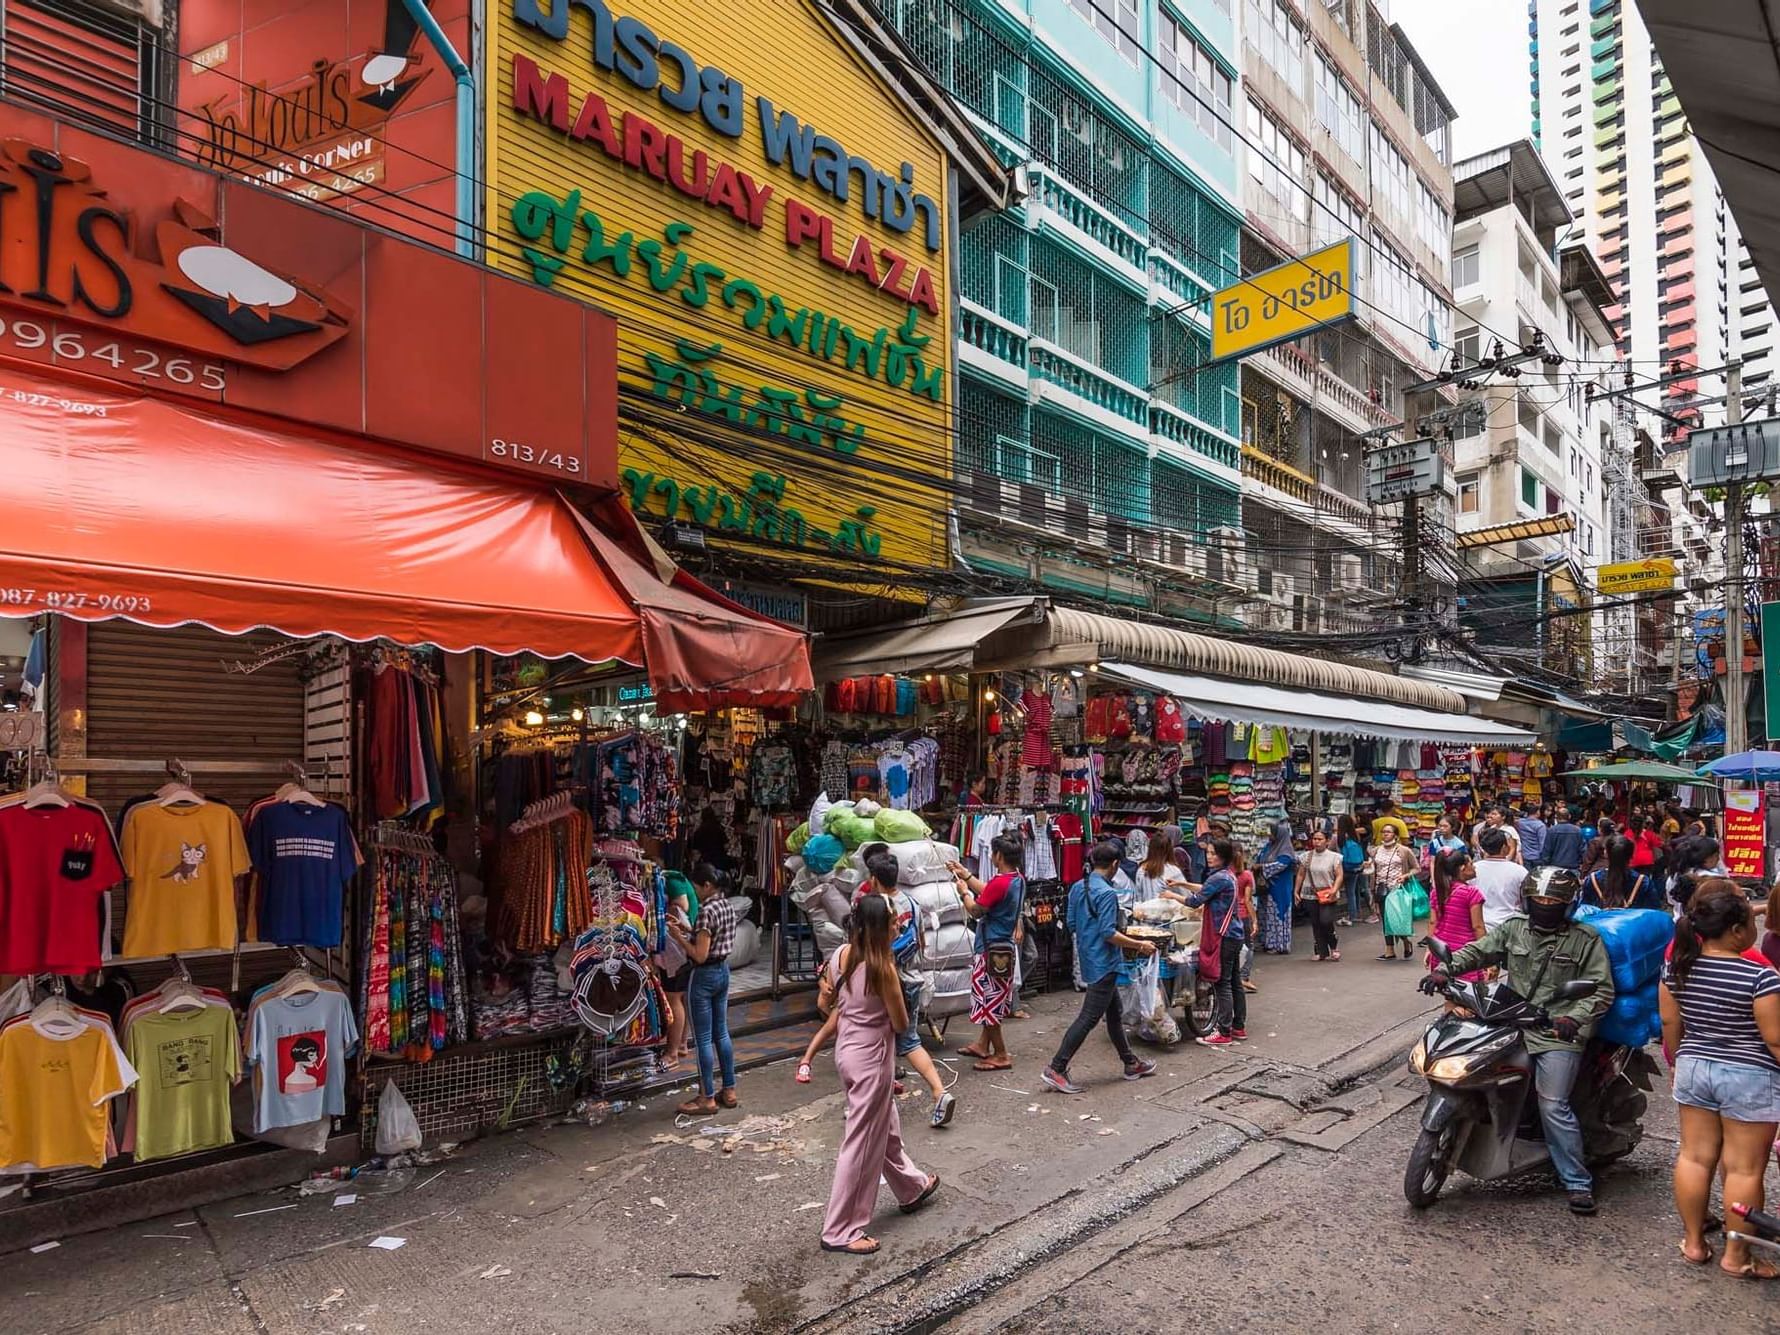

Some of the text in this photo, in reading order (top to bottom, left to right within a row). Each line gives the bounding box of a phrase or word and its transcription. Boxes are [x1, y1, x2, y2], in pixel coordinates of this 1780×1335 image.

[513, 52, 939, 316] MARUAY PLAZA
[757, 96, 939, 252] พลาซ่า
[0, 316, 226, 390] 964265
[1220, 298, 1250, 334] โอ
[491, 439, 581, 473] 813/43
